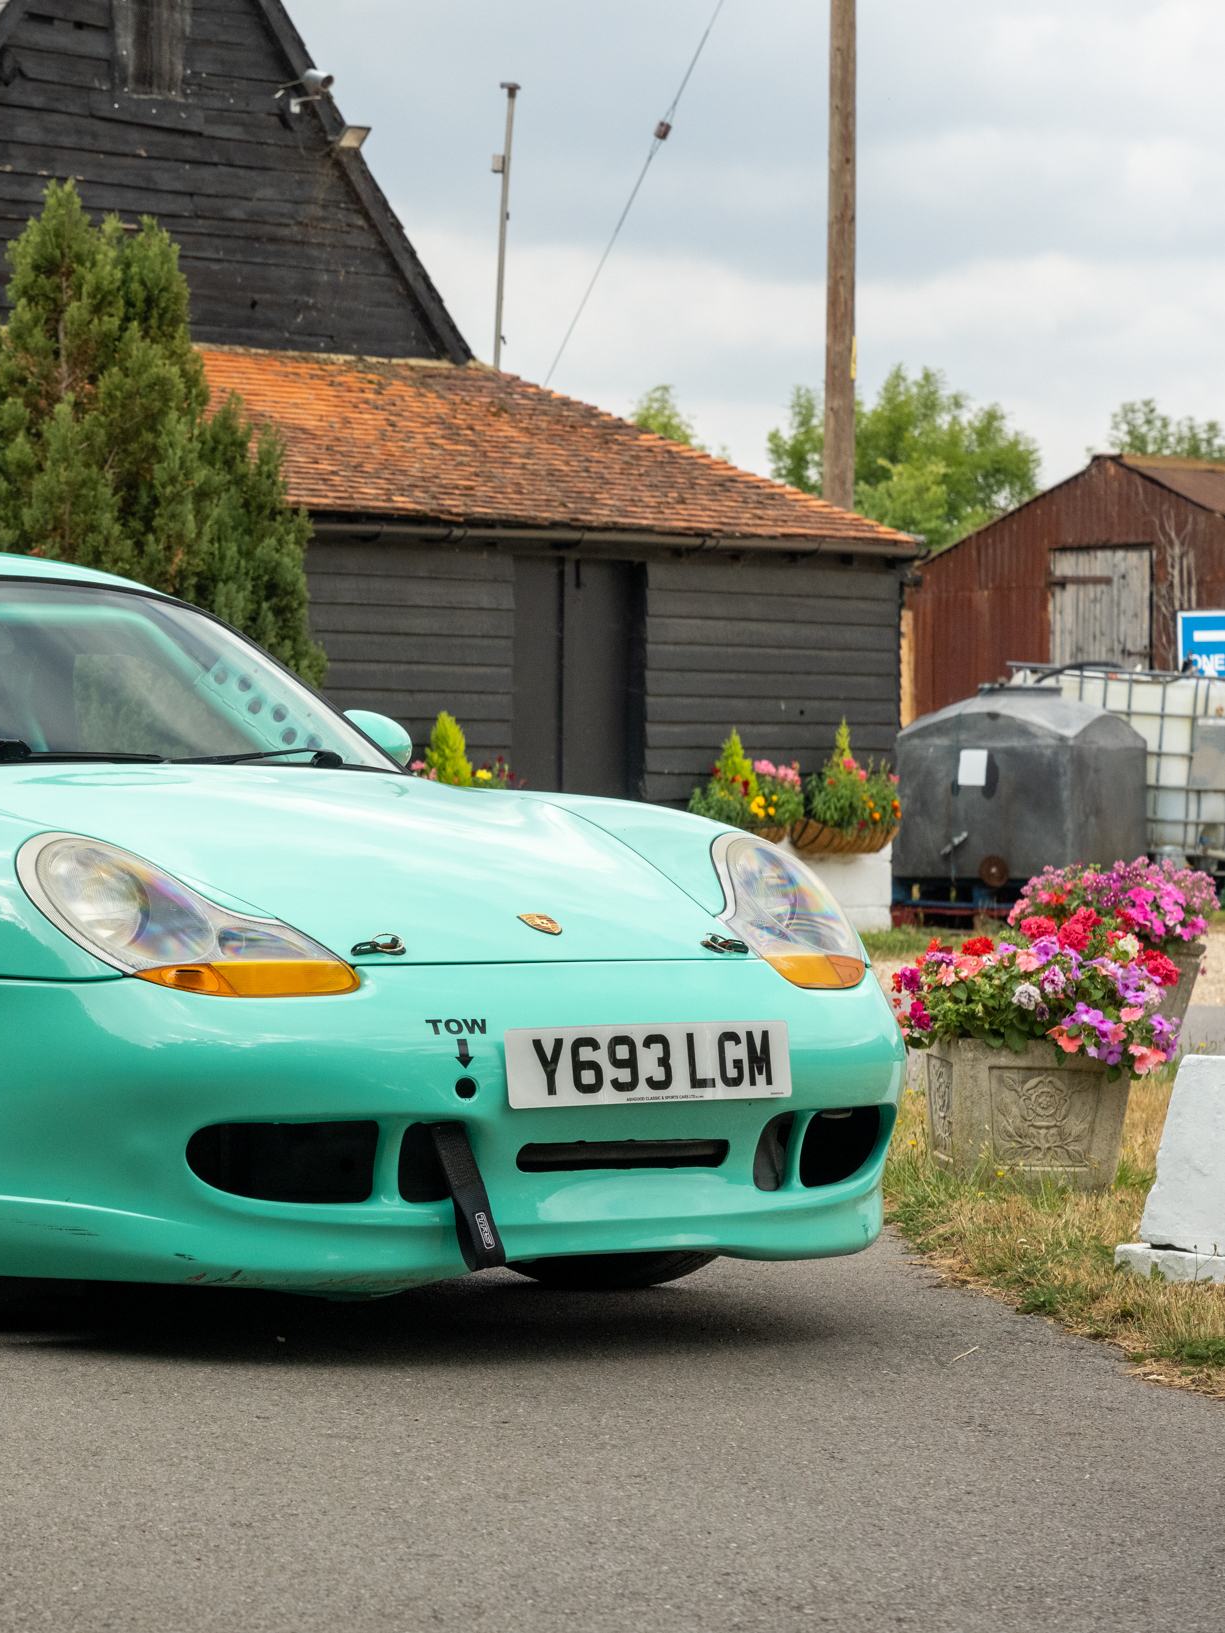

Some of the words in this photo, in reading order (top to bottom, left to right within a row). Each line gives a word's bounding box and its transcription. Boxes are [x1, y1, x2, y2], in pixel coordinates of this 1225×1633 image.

[425, 1018, 487, 1035] TOW
[532, 1033, 673, 1096] Y693
[686, 1030, 773, 1089] LGM
